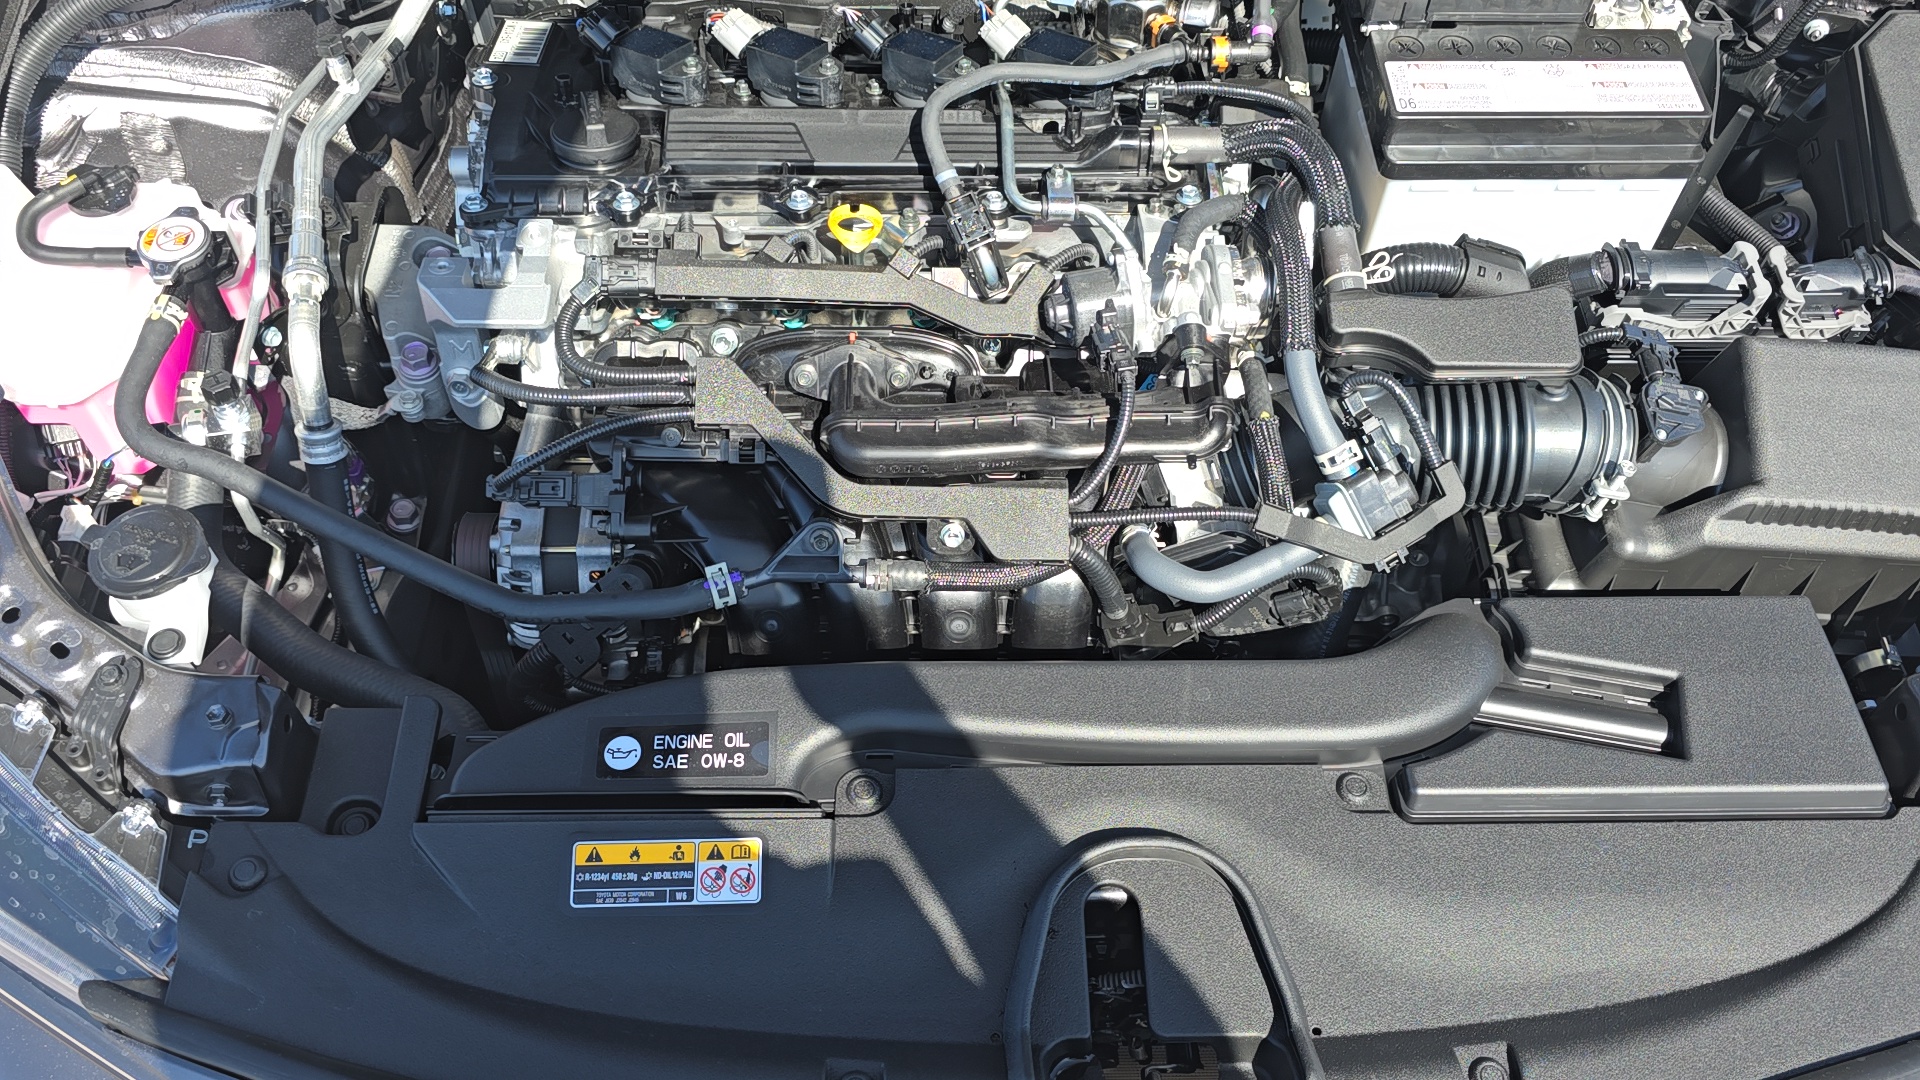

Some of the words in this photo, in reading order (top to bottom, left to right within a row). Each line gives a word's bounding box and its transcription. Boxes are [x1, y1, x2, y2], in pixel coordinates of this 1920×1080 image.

[654, 734, 713, 749] ENGINE
[724, 732, 750, 748] OIL
[652, 754, 689, 769] SAE
[701, 752, 745, 768] 0W-8
[187, 829, 208, 848] P
[675, 892, 687, 901] W6
